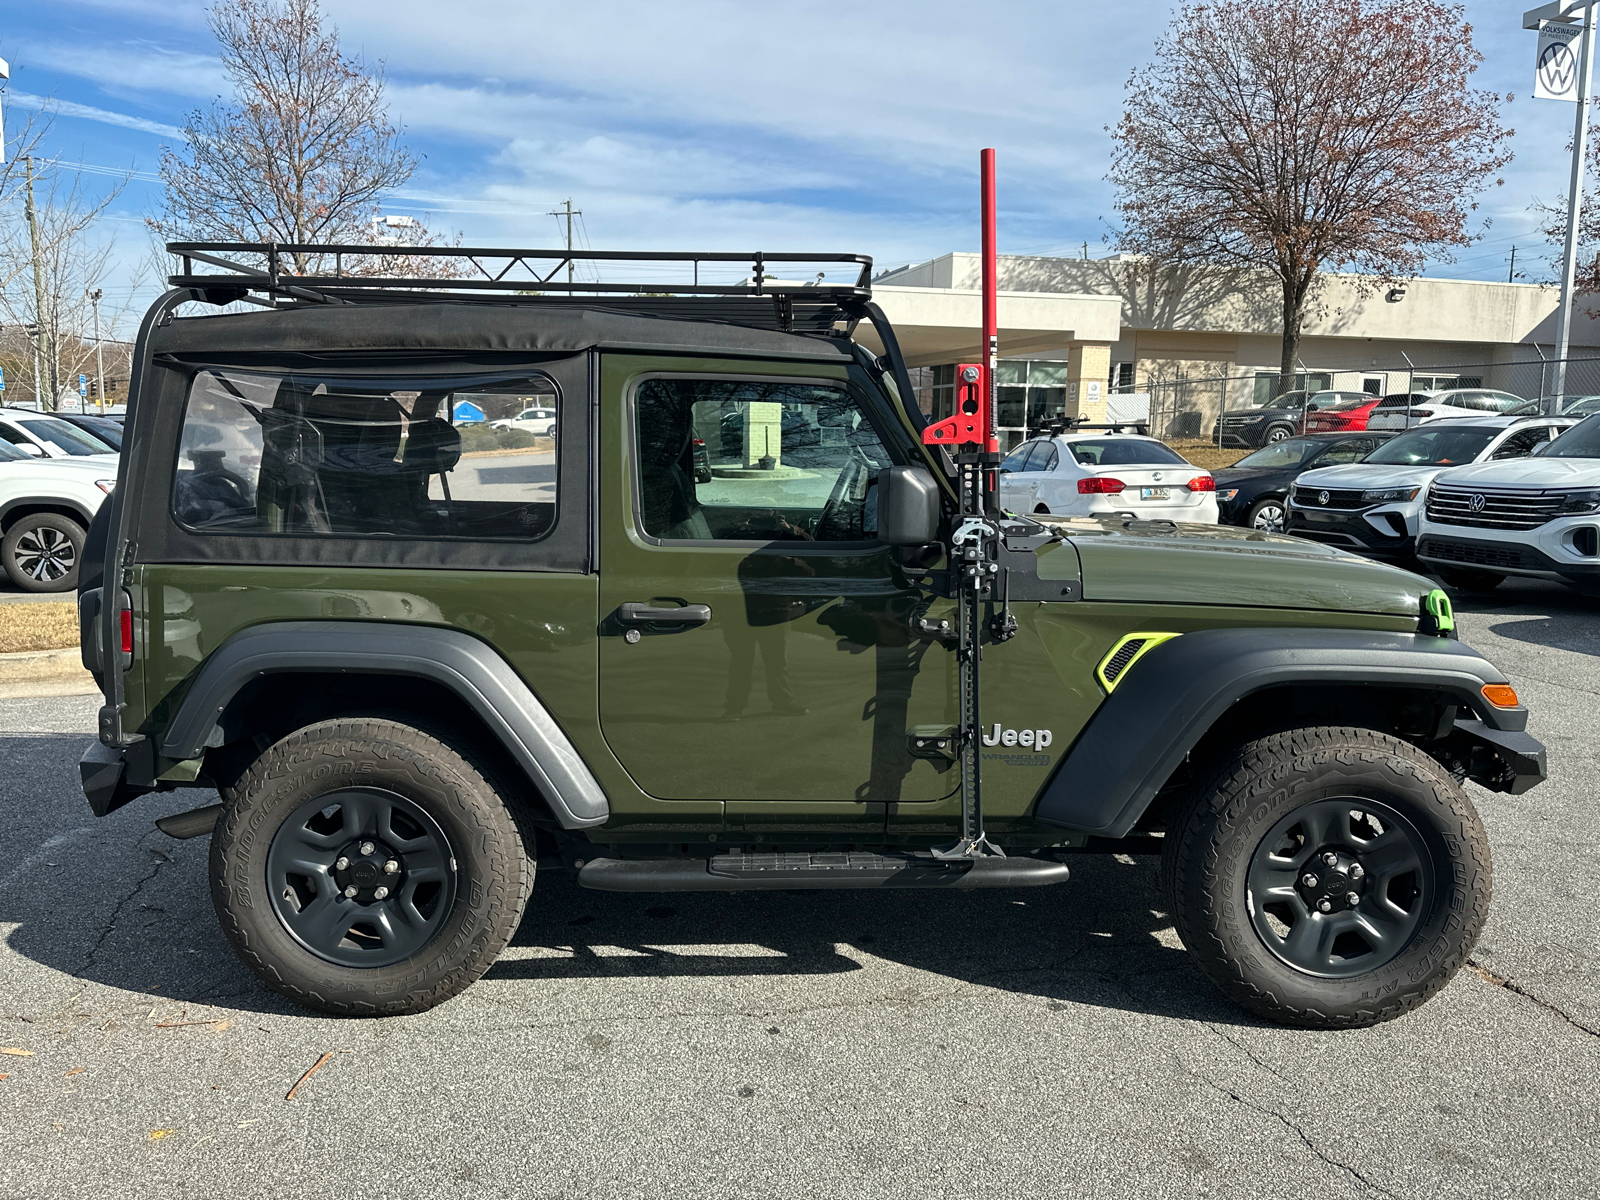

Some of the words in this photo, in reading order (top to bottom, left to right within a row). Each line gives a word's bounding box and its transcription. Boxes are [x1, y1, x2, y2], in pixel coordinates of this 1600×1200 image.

[1542, 26, 1581, 37] VOLKSWAGEN
[1548, 33, 1569, 41] MARIETTA
[982, 723, 1053, 752] Jeep
[234, 760, 378, 909] BRIDGESTONE
[1221, 777, 1306, 970] BRIDGESTONE
[374, 878, 484, 996] DUELER
[1408, 832, 1467, 982] DUELER
